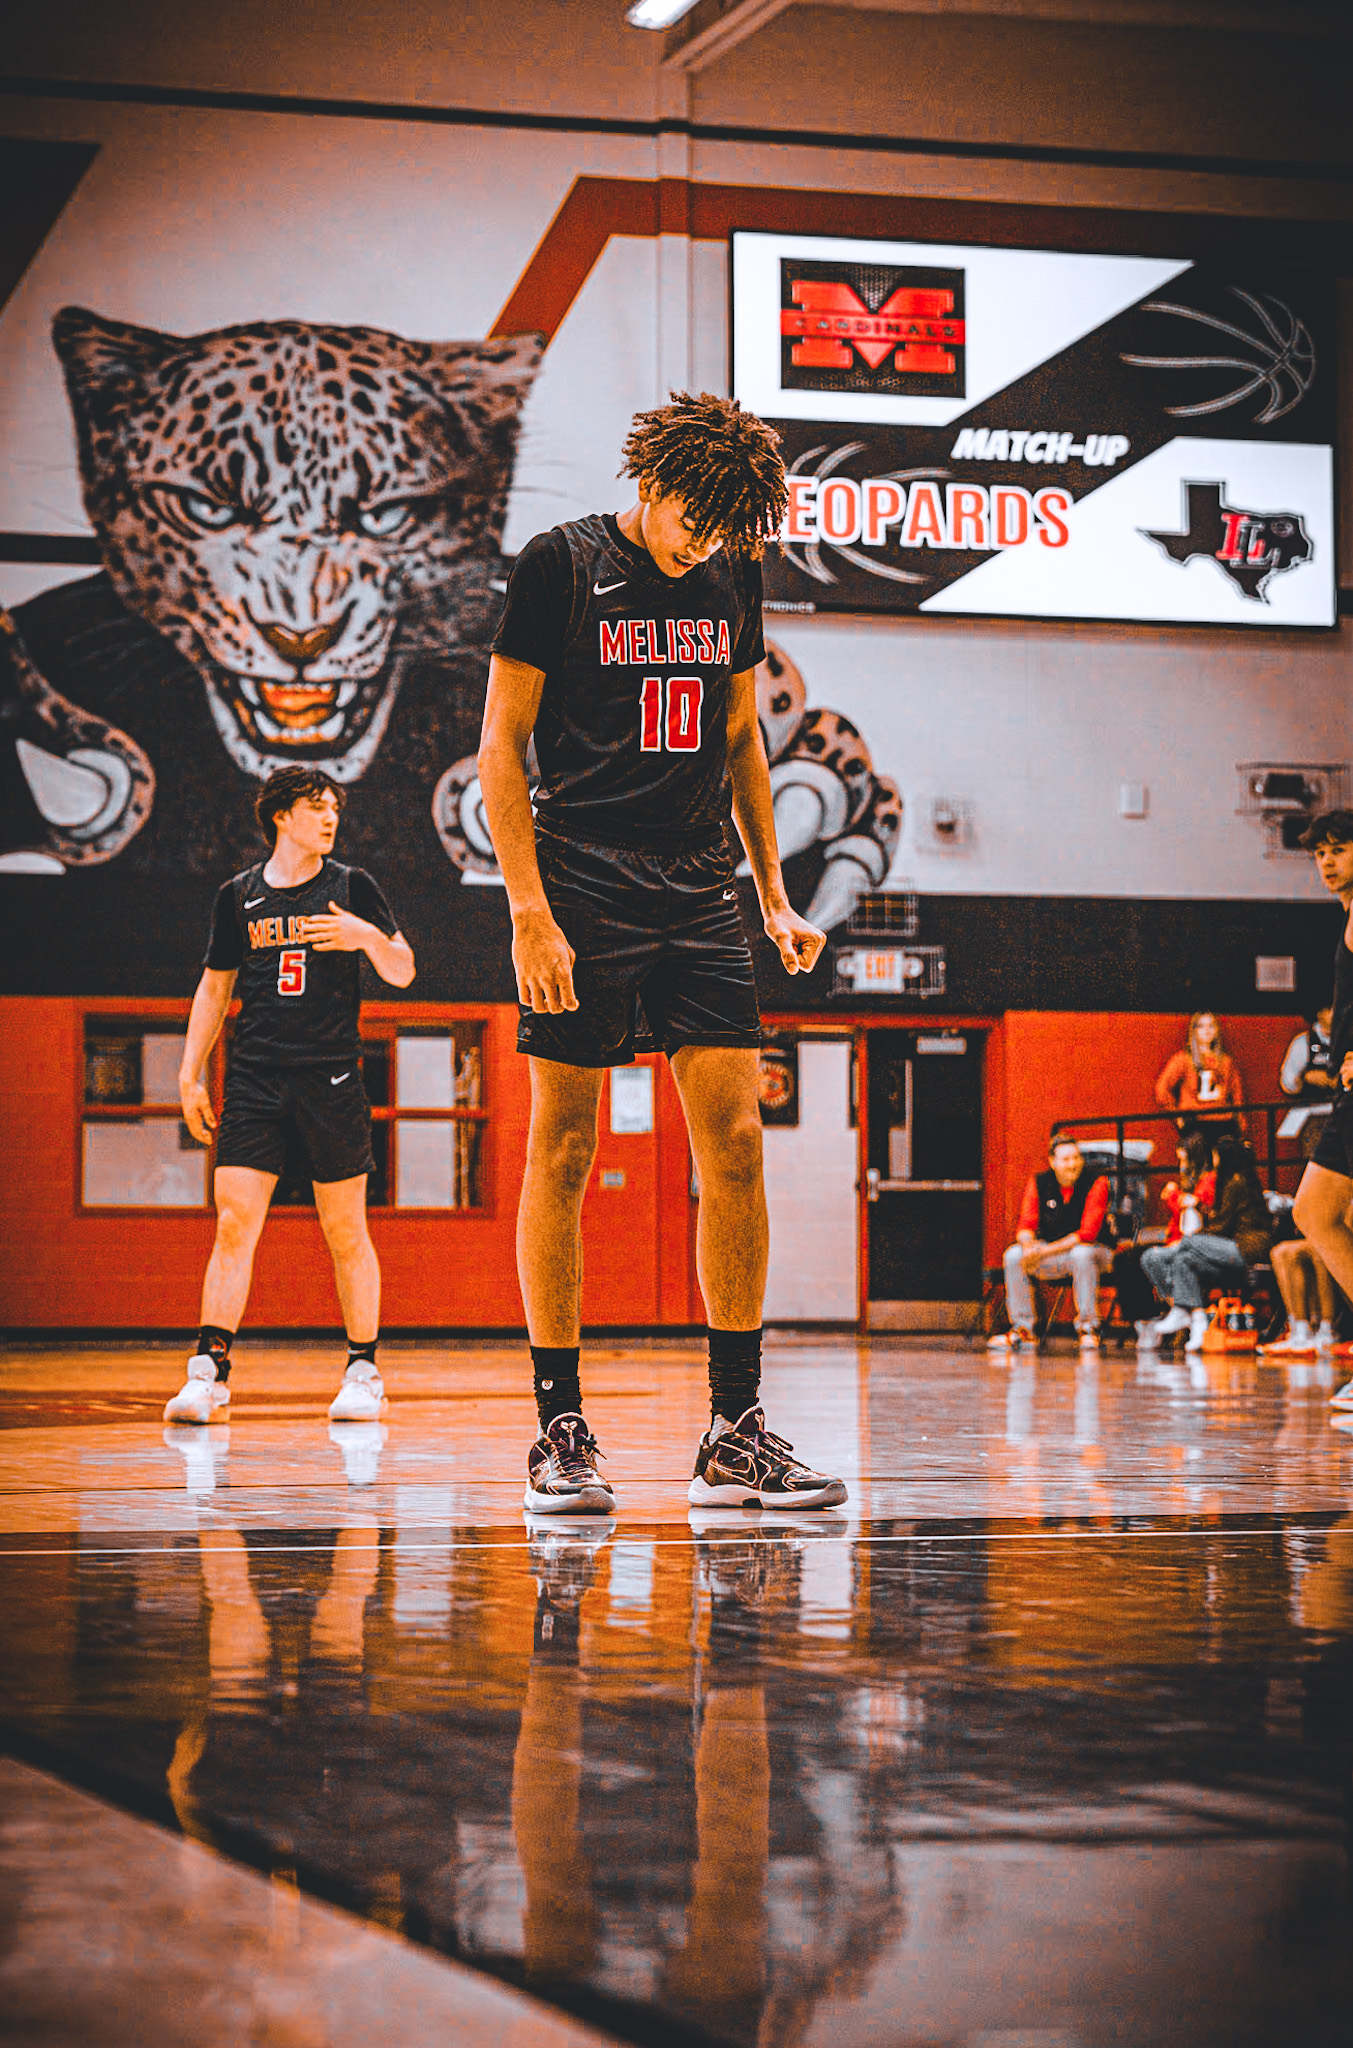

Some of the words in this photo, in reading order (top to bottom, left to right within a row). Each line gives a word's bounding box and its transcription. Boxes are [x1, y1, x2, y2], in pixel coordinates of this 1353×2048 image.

[796, 319, 955, 337] CARDINALS
[952, 429, 1130, 466] MATCH-UP
[784, 476, 1073, 549] EOPARDS
[600, 619, 730, 665] MELISSA
[639, 677, 704, 752] 10
[278, 950, 306, 996] 5
[1198, 1069, 1221, 1101] L
